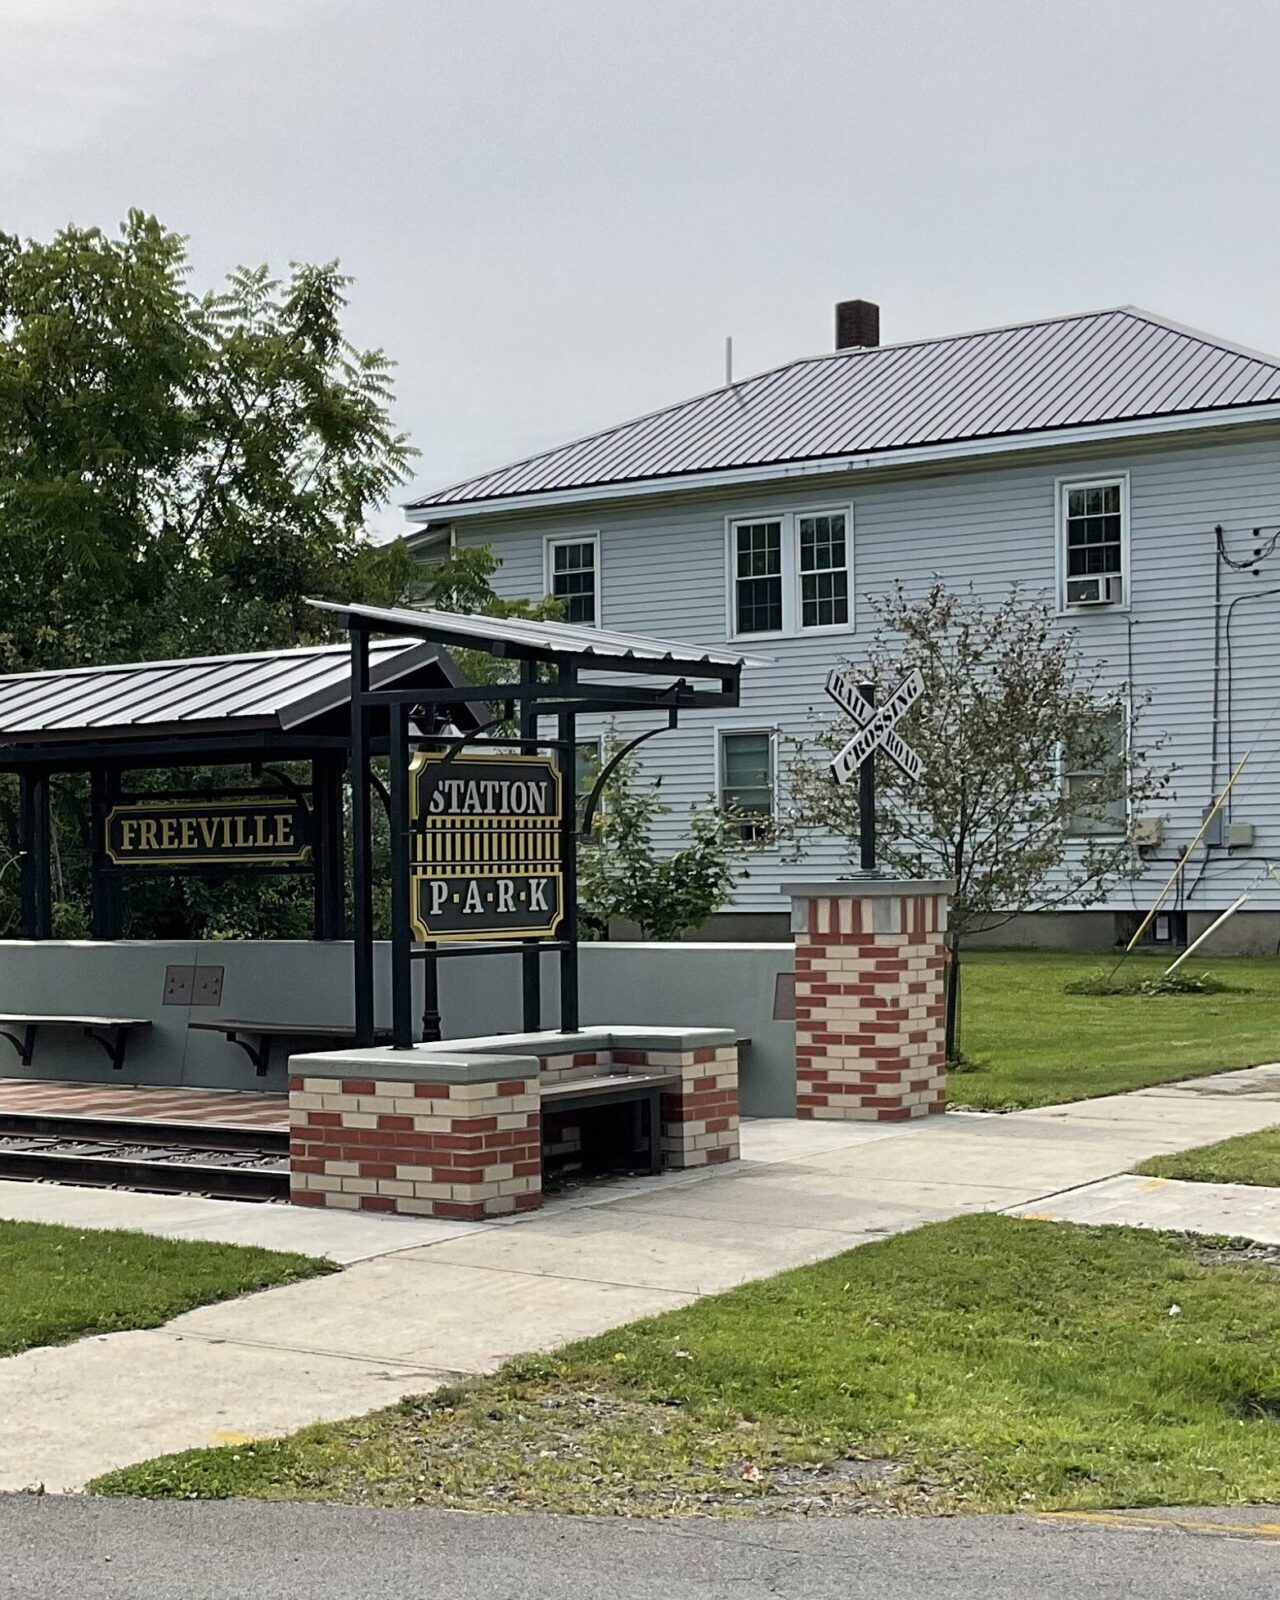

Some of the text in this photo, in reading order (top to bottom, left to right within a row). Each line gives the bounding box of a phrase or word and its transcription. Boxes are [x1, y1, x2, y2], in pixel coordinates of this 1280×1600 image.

[833, 674, 919, 773] RAIL ROAD
[843, 679, 918, 771] CROSSING
[429, 780, 548, 814] STATION
[120, 814, 294, 850] FREEVILLE
